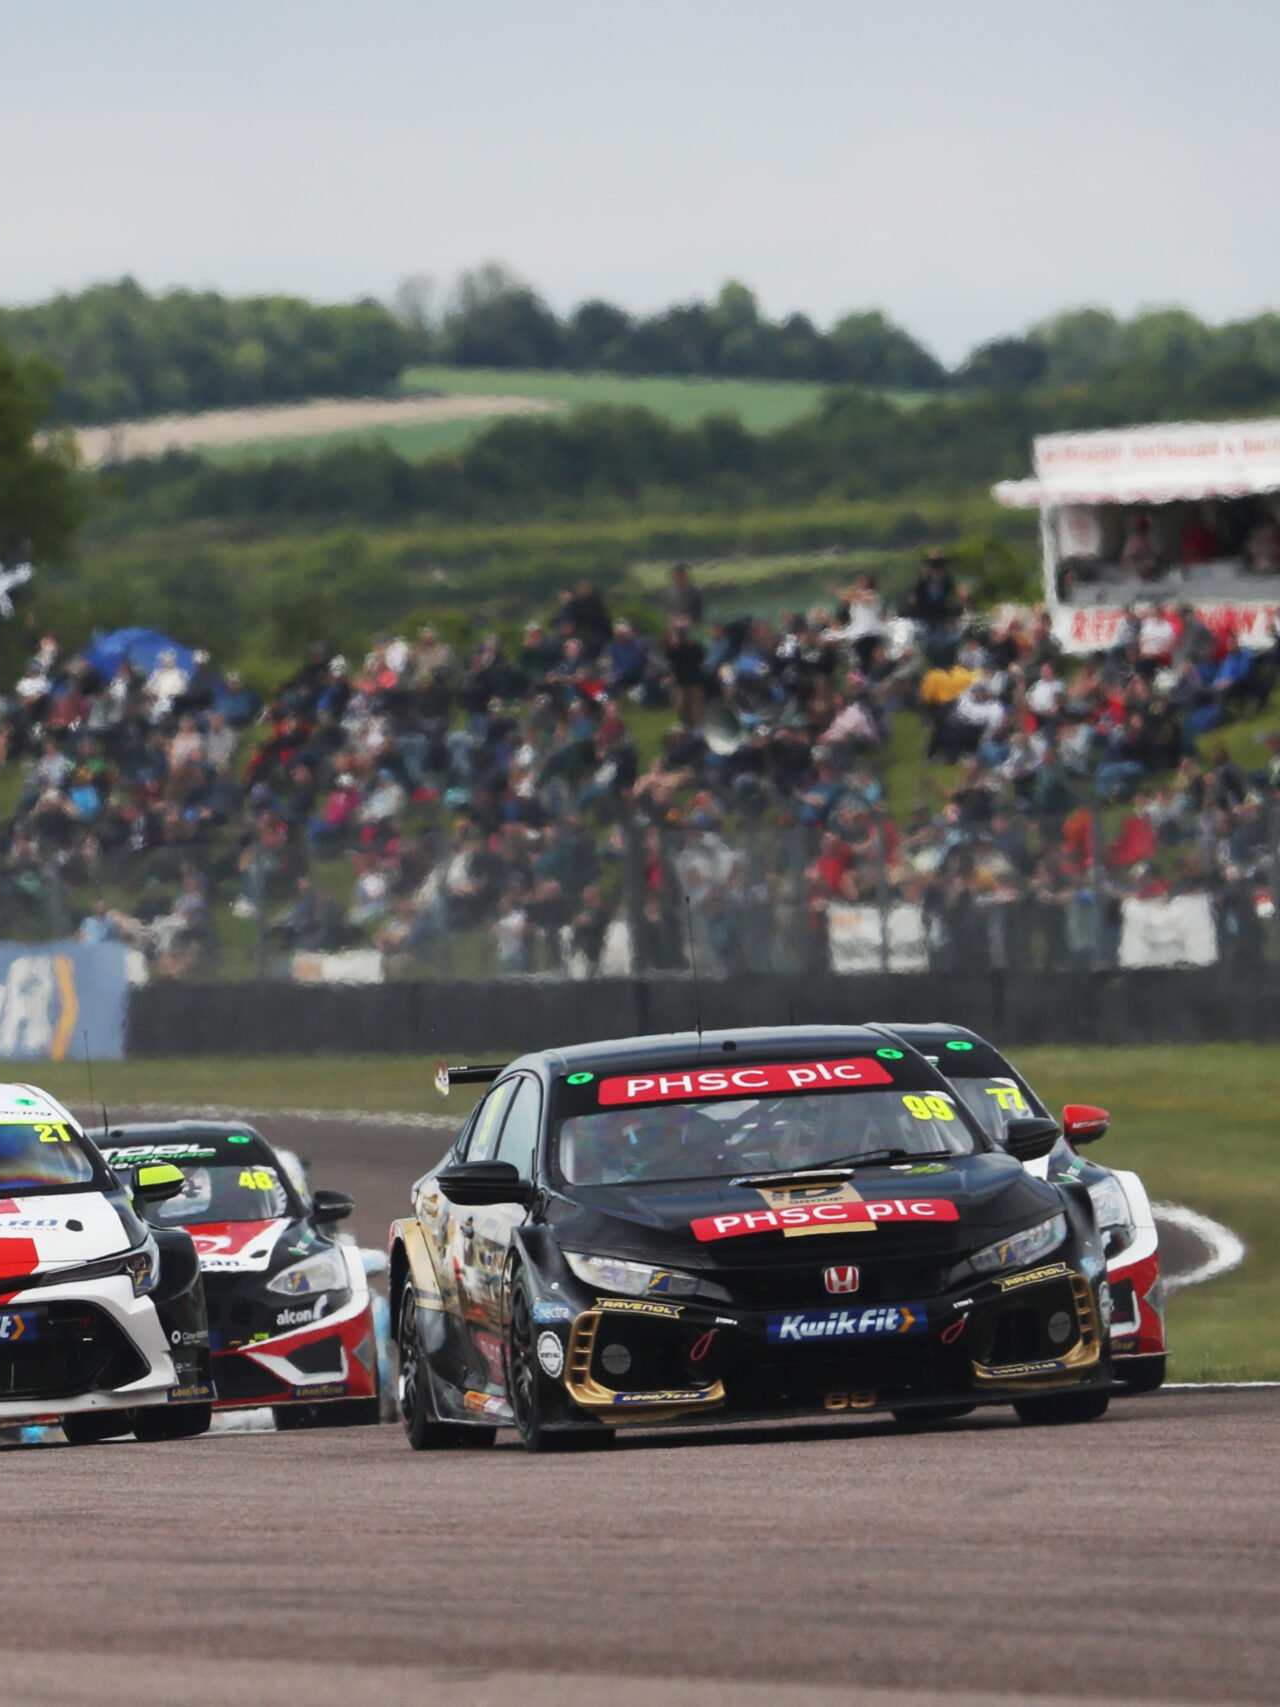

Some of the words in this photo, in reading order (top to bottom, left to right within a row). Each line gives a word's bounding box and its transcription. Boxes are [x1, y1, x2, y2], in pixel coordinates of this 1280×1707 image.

[627, 1069, 768, 1097] PHSC
[787, 1063, 862, 1087] plc
[902, 1095, 955, 1121] 99
[985, 1087, 1026, 1110] 77
[34, 1124, 72, 1143] 21
[713, 1205, 847, 1233] PHSC
[865, 1199, 936, 1221] plc
[1004, 1267, 1065, 1286] RAVENOL
[602, 1301, 674, 1314] RAVENOL
[276, 1309, 311, 1326] alcon
[993, 1362, 1057, 1375] GOODYEAR
[622, 1392, 701, 1402] GOODYEAR
